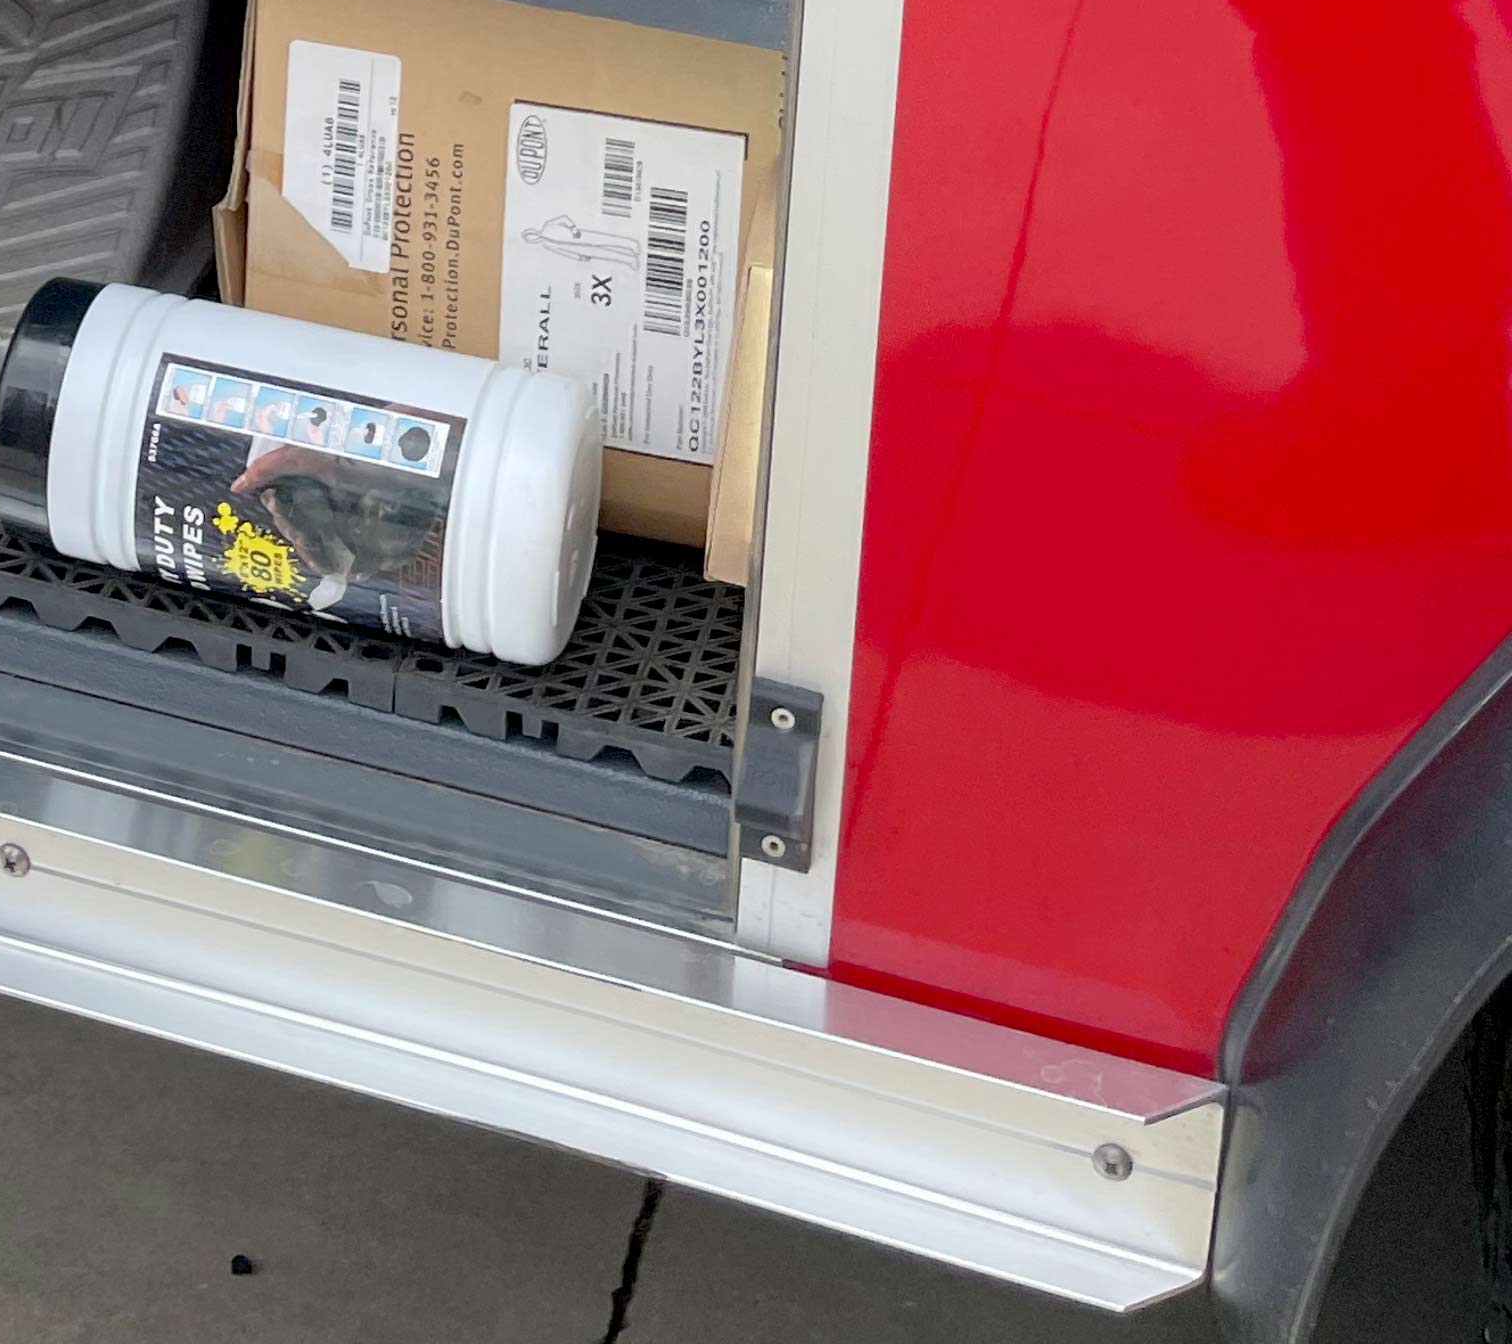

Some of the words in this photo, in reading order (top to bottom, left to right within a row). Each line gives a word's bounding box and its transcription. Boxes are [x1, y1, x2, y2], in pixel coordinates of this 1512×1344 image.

[390, 133, 415, 260] Protection
[420, 156, 441, 301] 1-800-931-3456
[441, 143, 465, 350] Protection.DuPont.com
[536, 285, 552, 372] ERALL
[590, 273, 613, 307] 3X
[154, 495, 176, 570] DUTY
[249, 549, 274, 582] 80
[274, 552, 284, 585] WIPES
